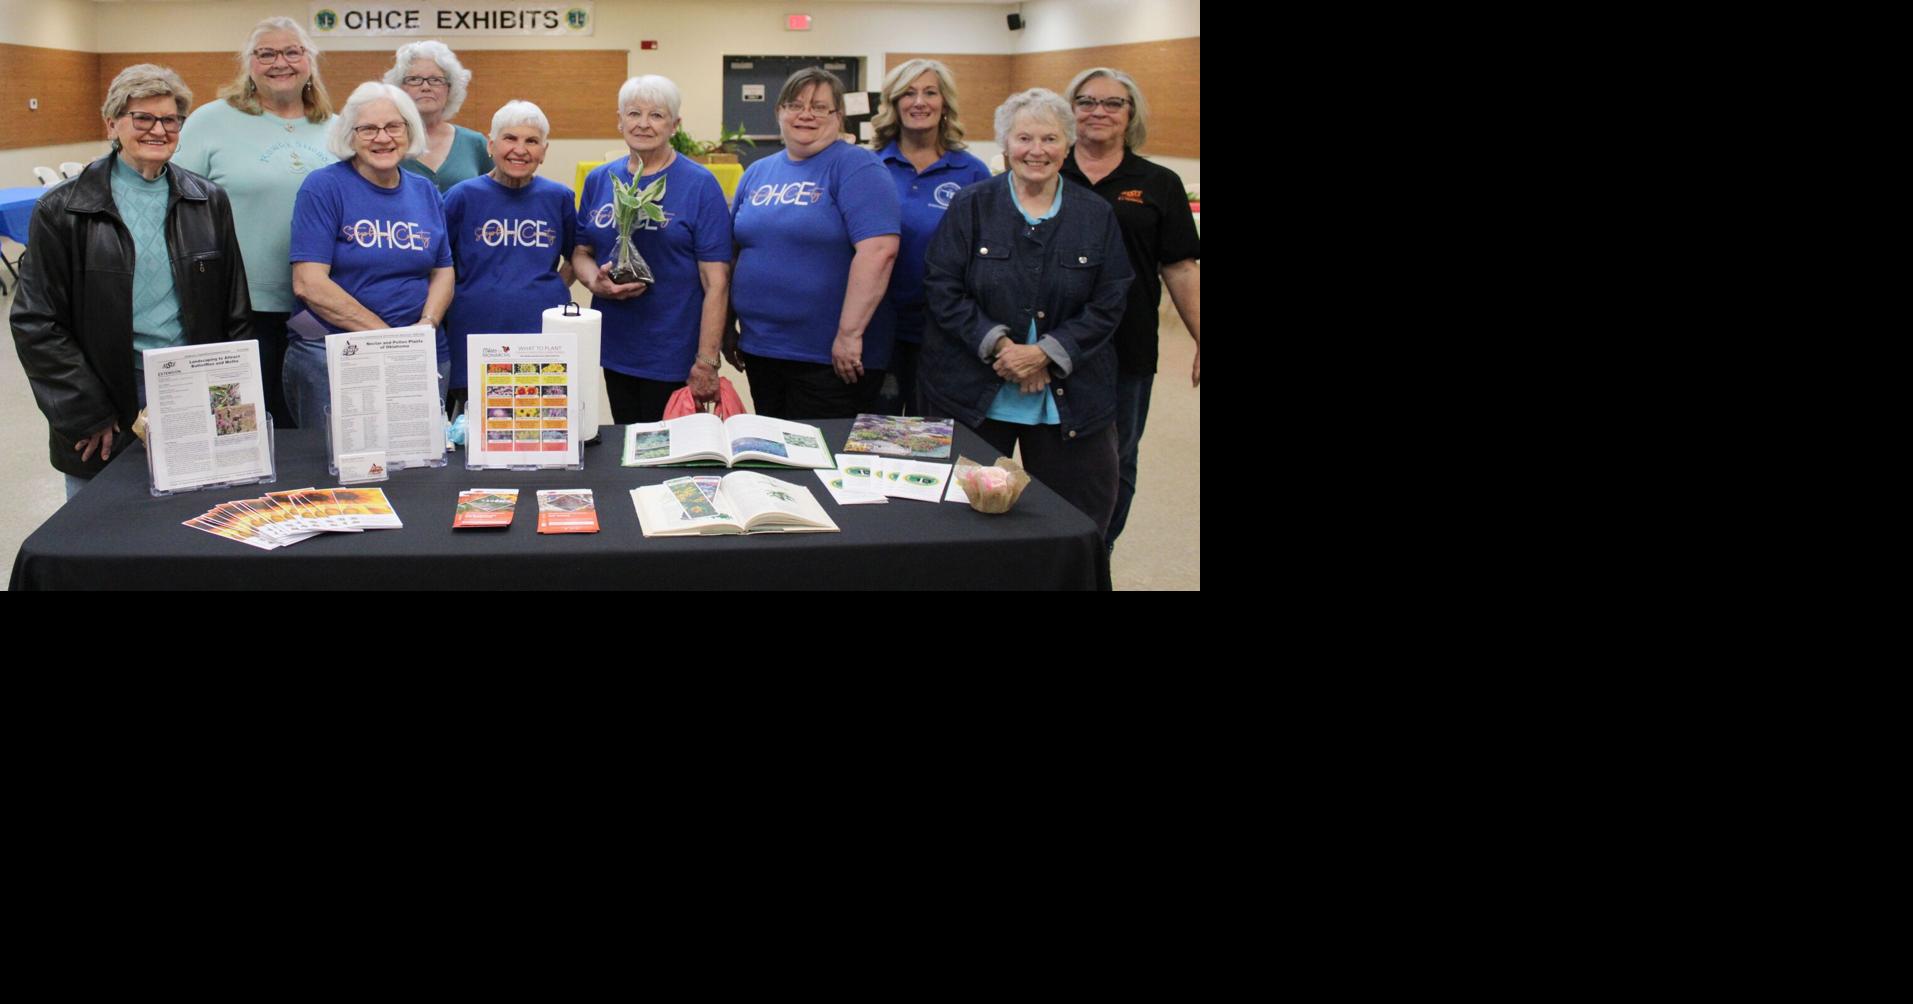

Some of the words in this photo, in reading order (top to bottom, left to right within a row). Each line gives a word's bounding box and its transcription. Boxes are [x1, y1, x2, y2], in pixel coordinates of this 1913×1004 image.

[344, 10, 421, 30] OHCE
[436, 10, 560, 30] EXHIBITS
[752, 181, 817, 207] OHCE
[353, 218, 424, 252] OHCE
[482, 218, 550, 249] OHCE
